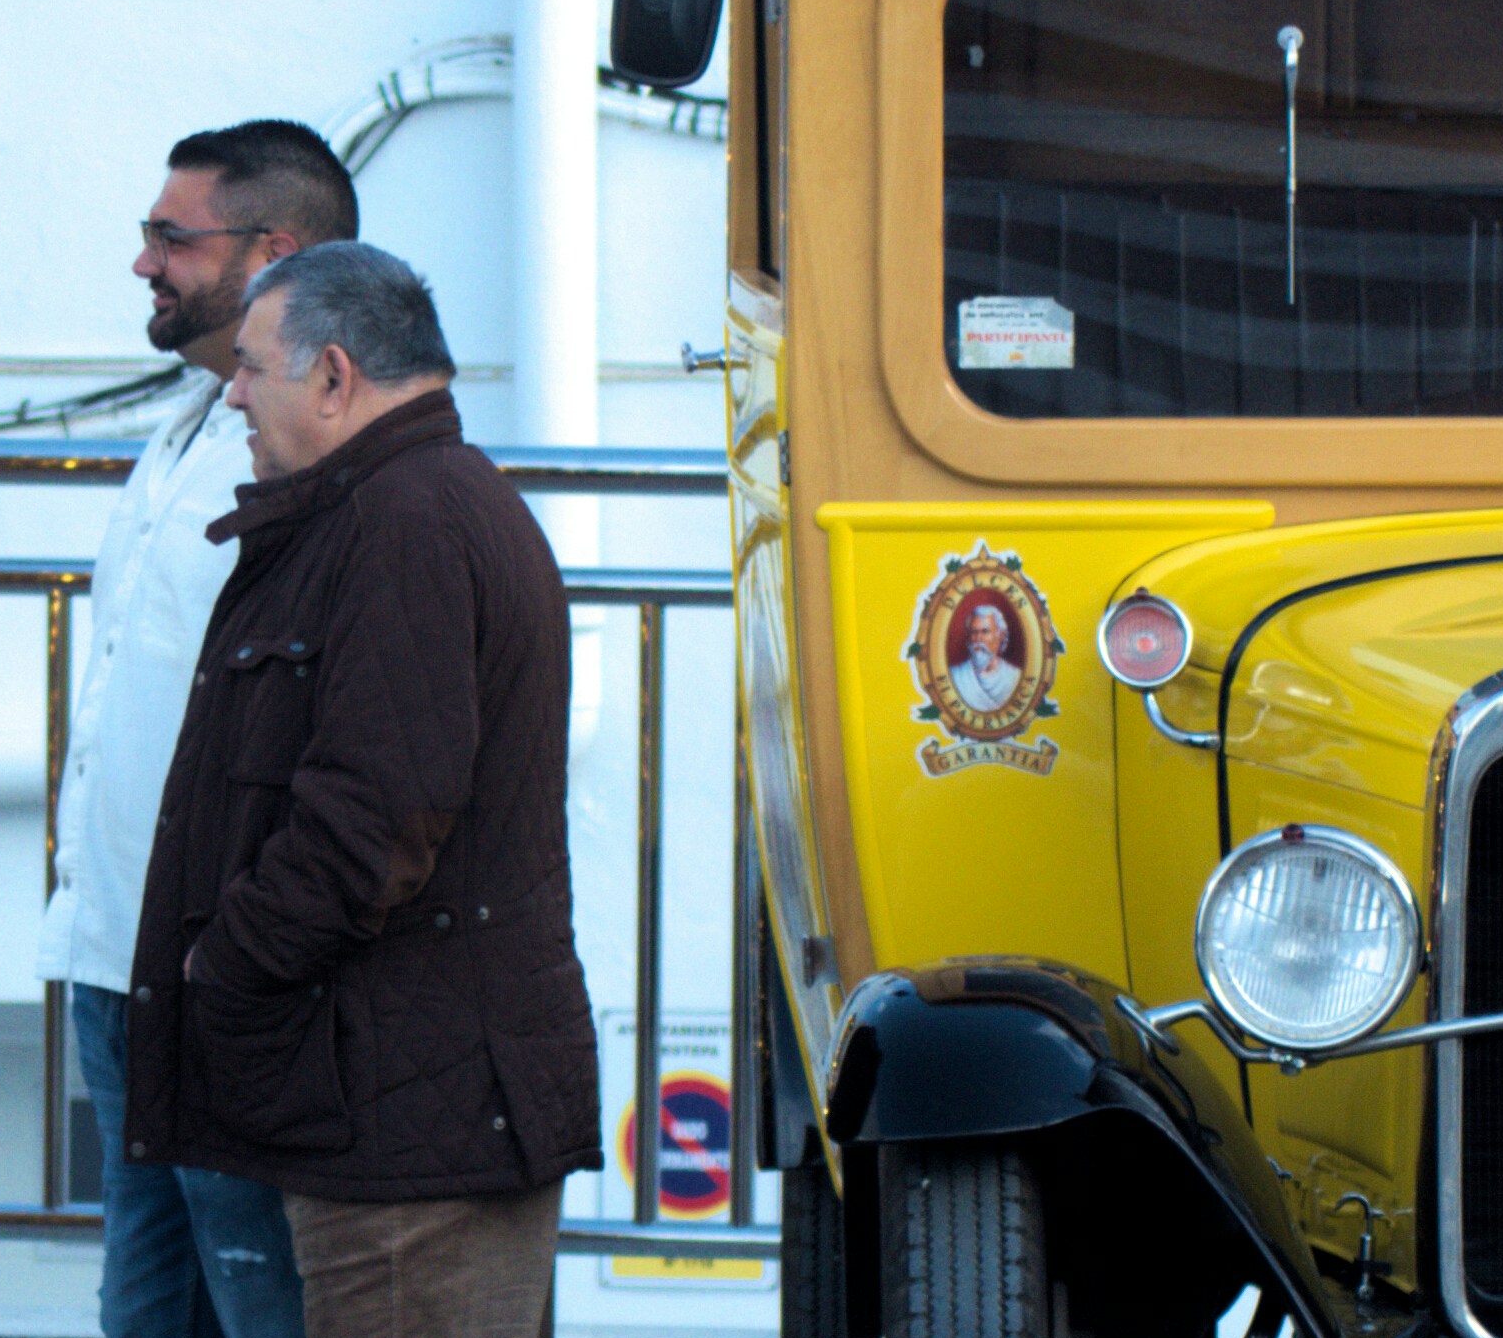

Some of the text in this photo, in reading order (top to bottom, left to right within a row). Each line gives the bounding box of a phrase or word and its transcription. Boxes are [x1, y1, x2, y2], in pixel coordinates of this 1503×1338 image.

[943, 573, 1028, 611] DULCES
[946, 675, 1037, 730] PATRIARCA
[936, 744, 1041, 770] GARANTIA
